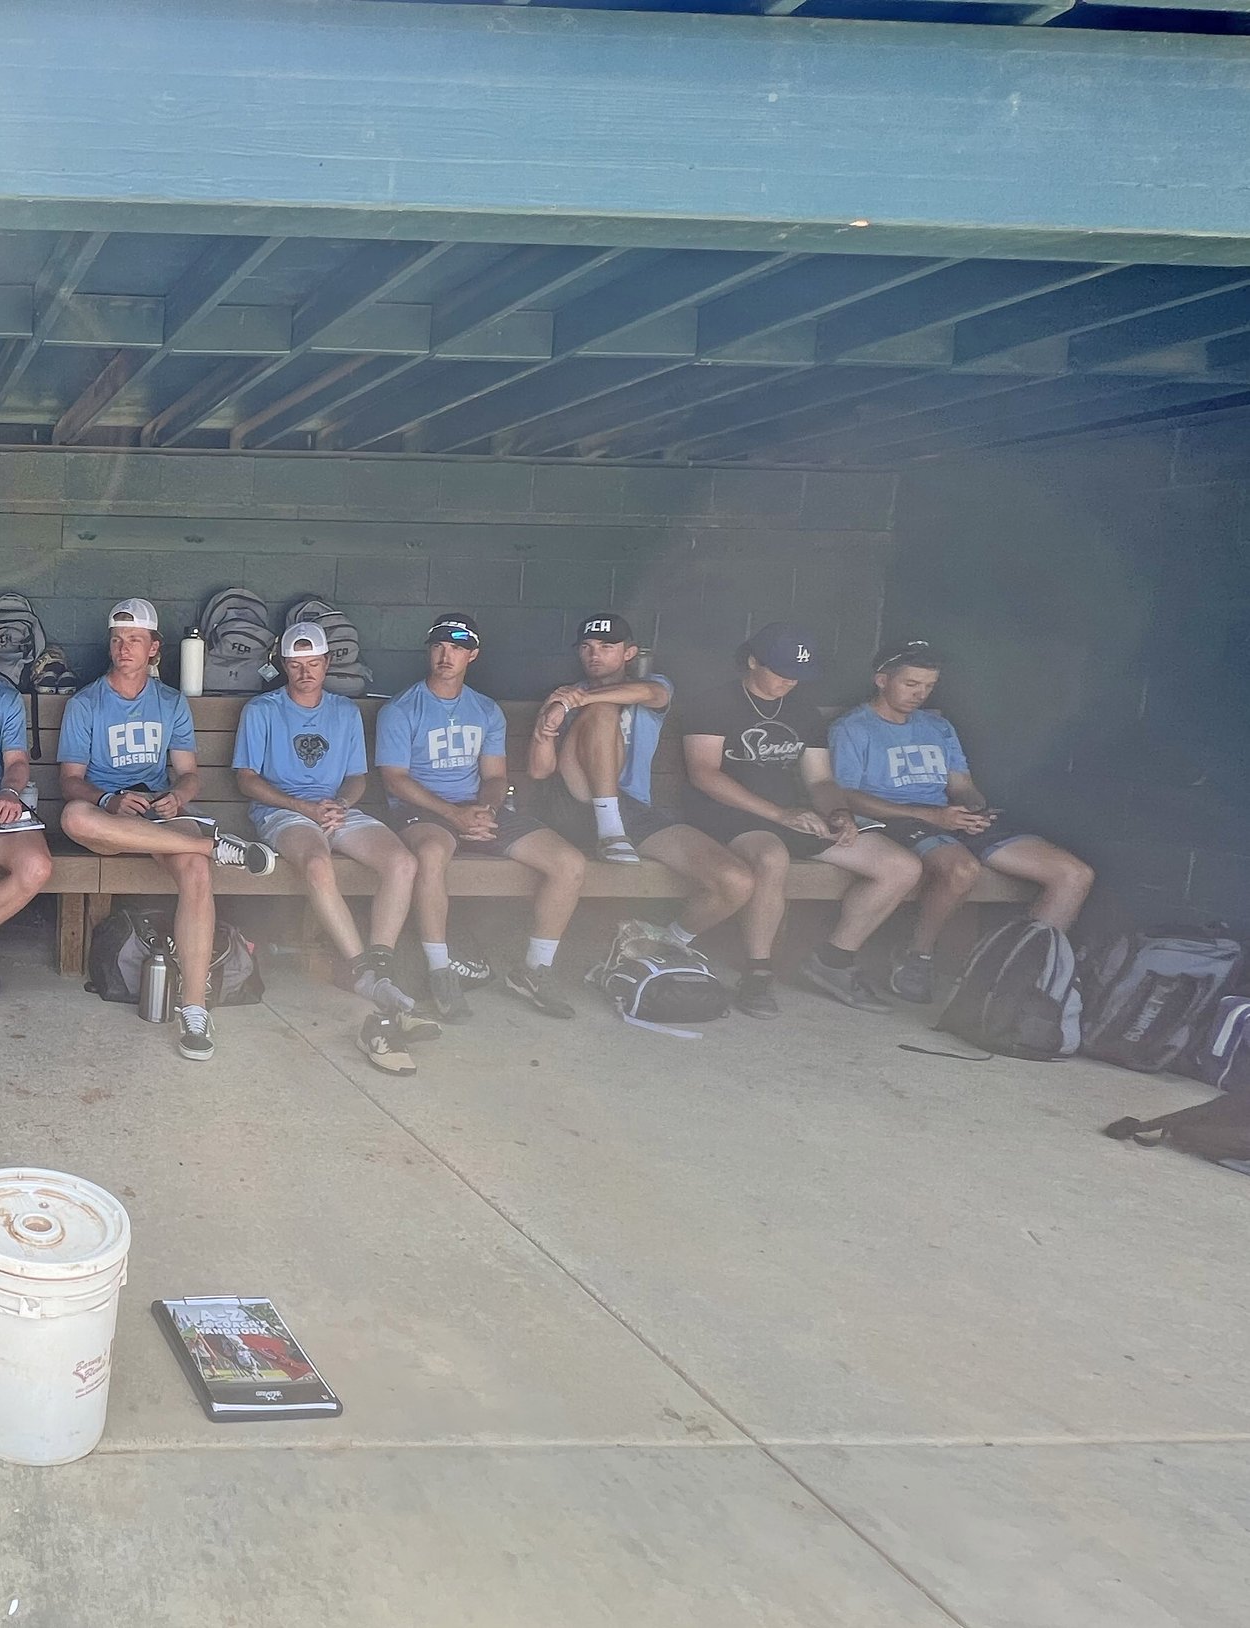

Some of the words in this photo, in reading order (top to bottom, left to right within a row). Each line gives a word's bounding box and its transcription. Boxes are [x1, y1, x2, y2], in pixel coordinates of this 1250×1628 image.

[584, 620, 611, 634] FCA
[796, 644, 811, 663] LA
[108, 721, 162, 758] FCA
[428, 724, 482, 760] FCA
[724, 727, 805, 761] Senior
[886, 744, 948, 778] FCA
[196, 1327, 269, 1335] HANDBOOK
